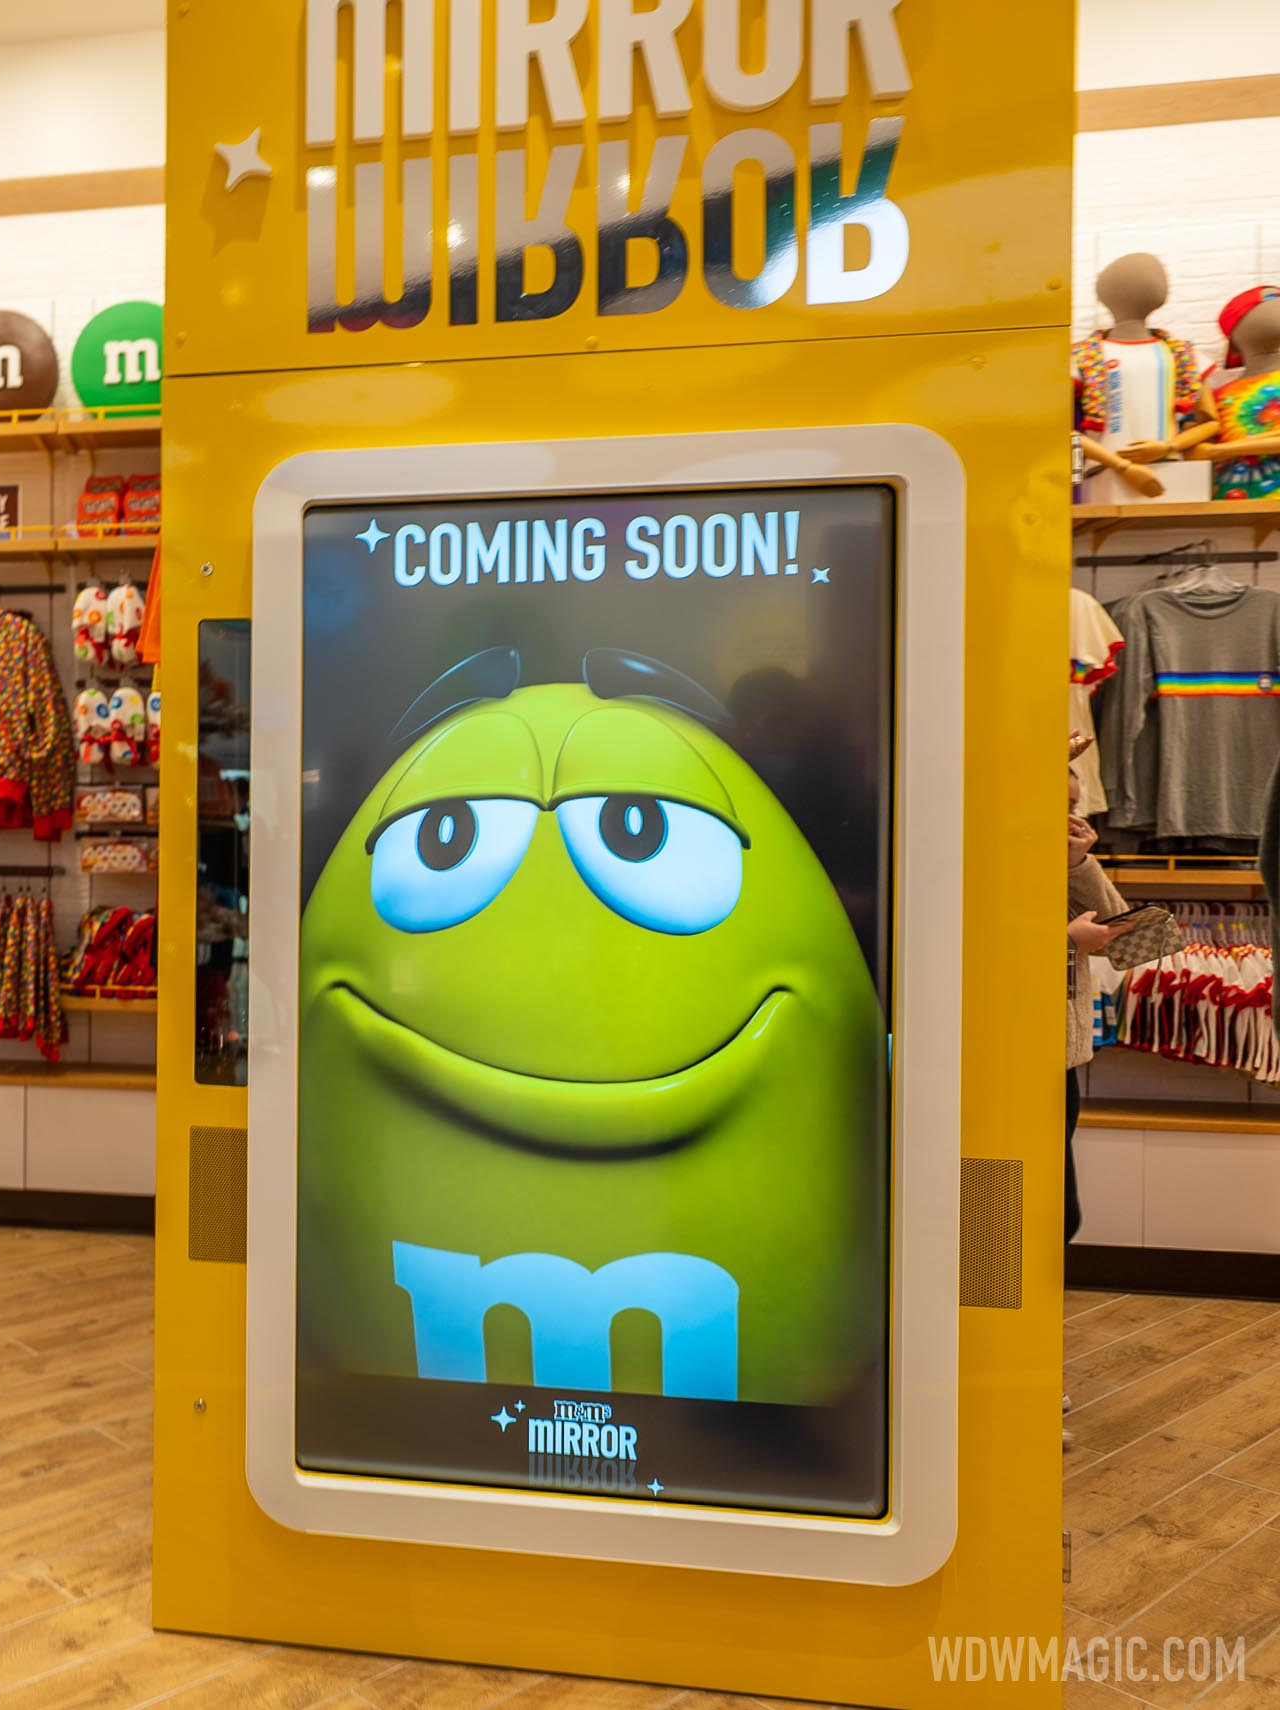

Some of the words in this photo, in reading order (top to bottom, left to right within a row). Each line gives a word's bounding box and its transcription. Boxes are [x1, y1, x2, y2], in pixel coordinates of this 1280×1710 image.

[104, 336, 162, 386] m
[393, 517, 607, 587] COMING
[624, 510, 800, 580] SOON!
[392, 1240, 739, 1402] m
